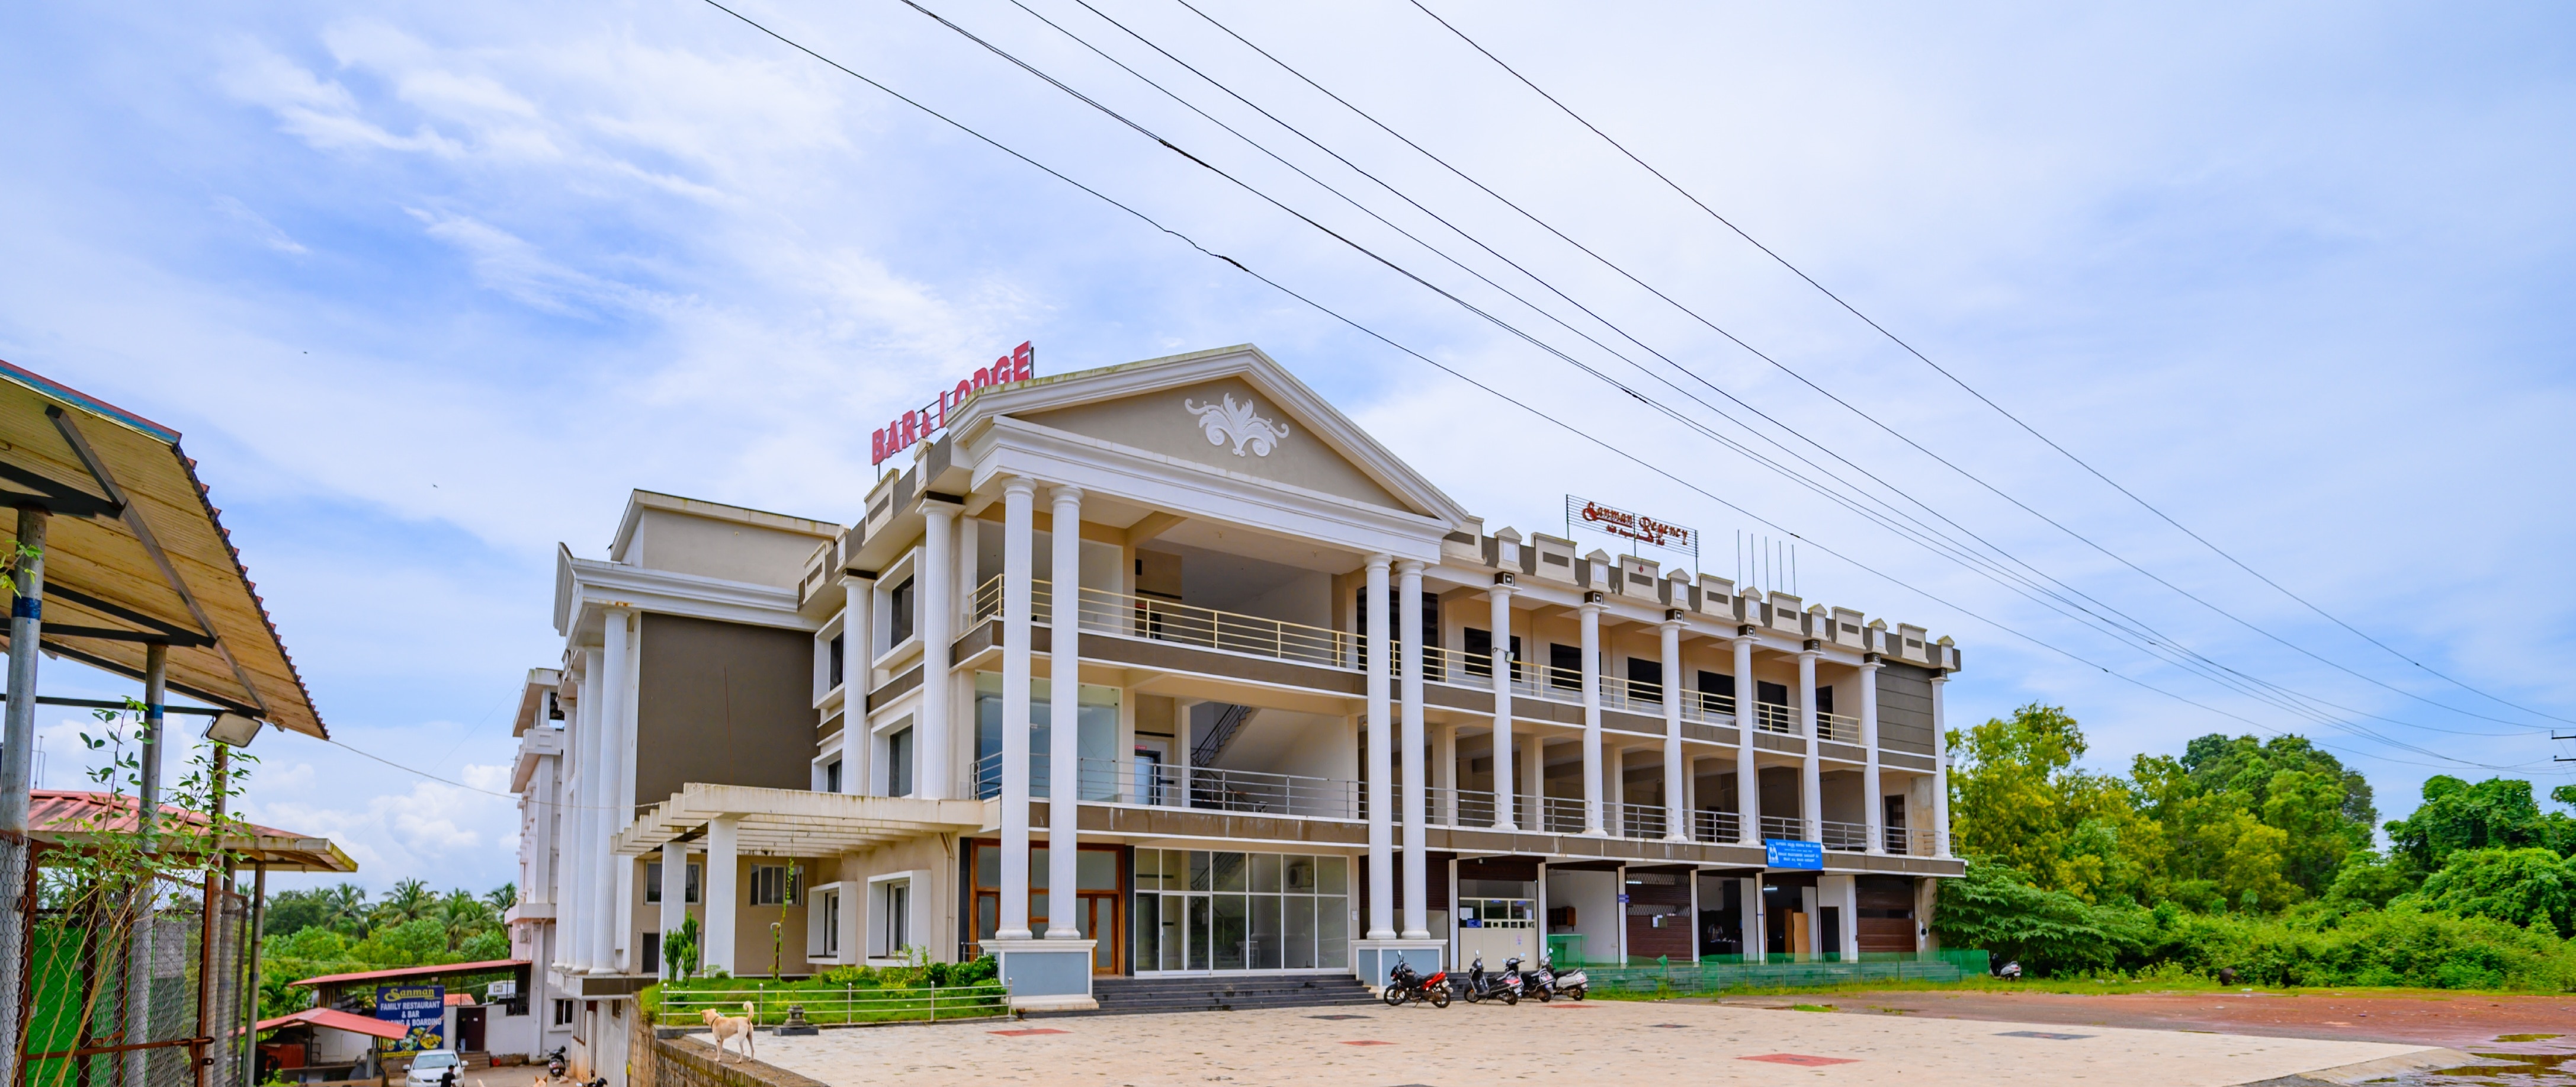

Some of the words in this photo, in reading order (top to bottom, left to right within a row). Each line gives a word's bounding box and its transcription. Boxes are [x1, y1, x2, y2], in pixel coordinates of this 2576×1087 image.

[872, 409, 918, 466] BAR
[920, 411, 933, 439] &
[1582, 501, 1632, 528] Sanman
[1638, 517, 1688, 545] Regency
[380, 1002, 401, 1011] FAMILY
[403, 1001, 440, 1009] RESTAURANT
[384, 988, 434, 1002] Sanman
